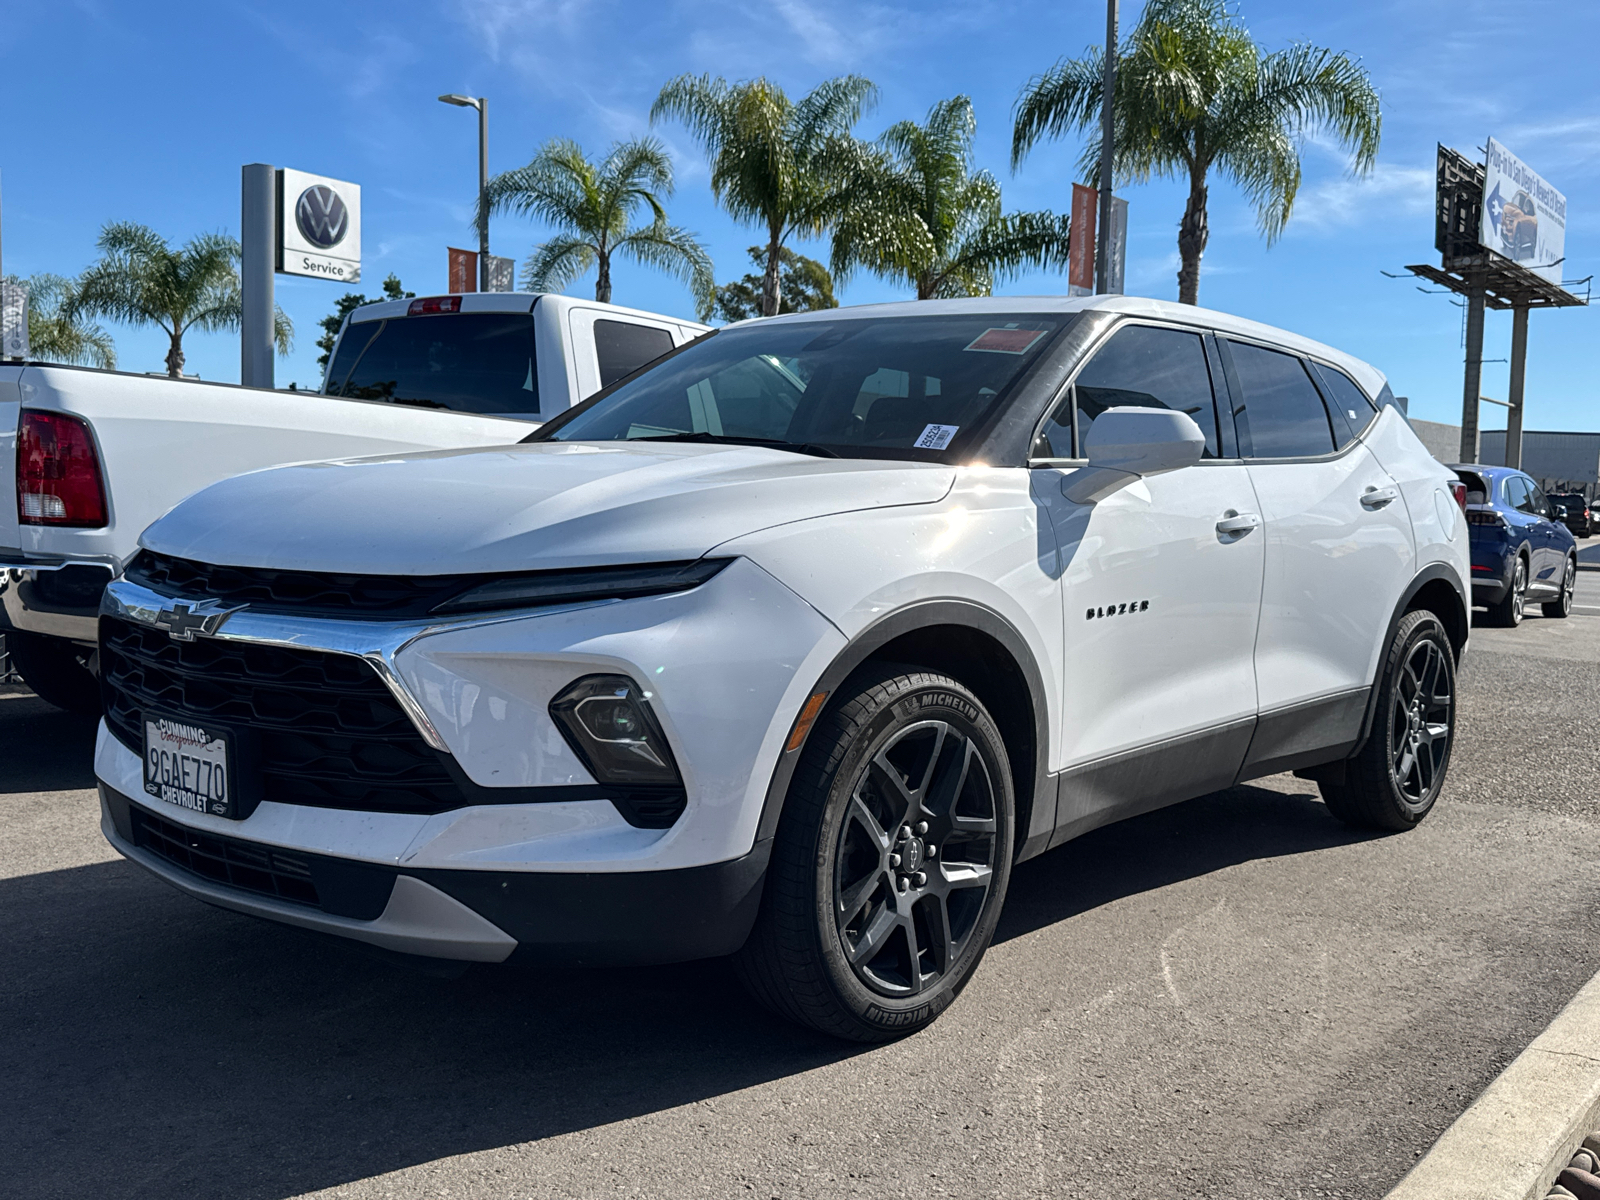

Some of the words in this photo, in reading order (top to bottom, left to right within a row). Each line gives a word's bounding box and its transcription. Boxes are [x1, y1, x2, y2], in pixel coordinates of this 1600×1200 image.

[302, 257, 344, 276] Service
[1086, 600, 1149, 620] BLAZER
[921, 694, 977, 719] MICHELIN
[159, 718, 206, 744] CUMMING
[150, 746, 225, 801] 9GAE770
[161, 784, 207, 812] CHEVROLET
[866, 1005, 929, 1025] MICHELIN
